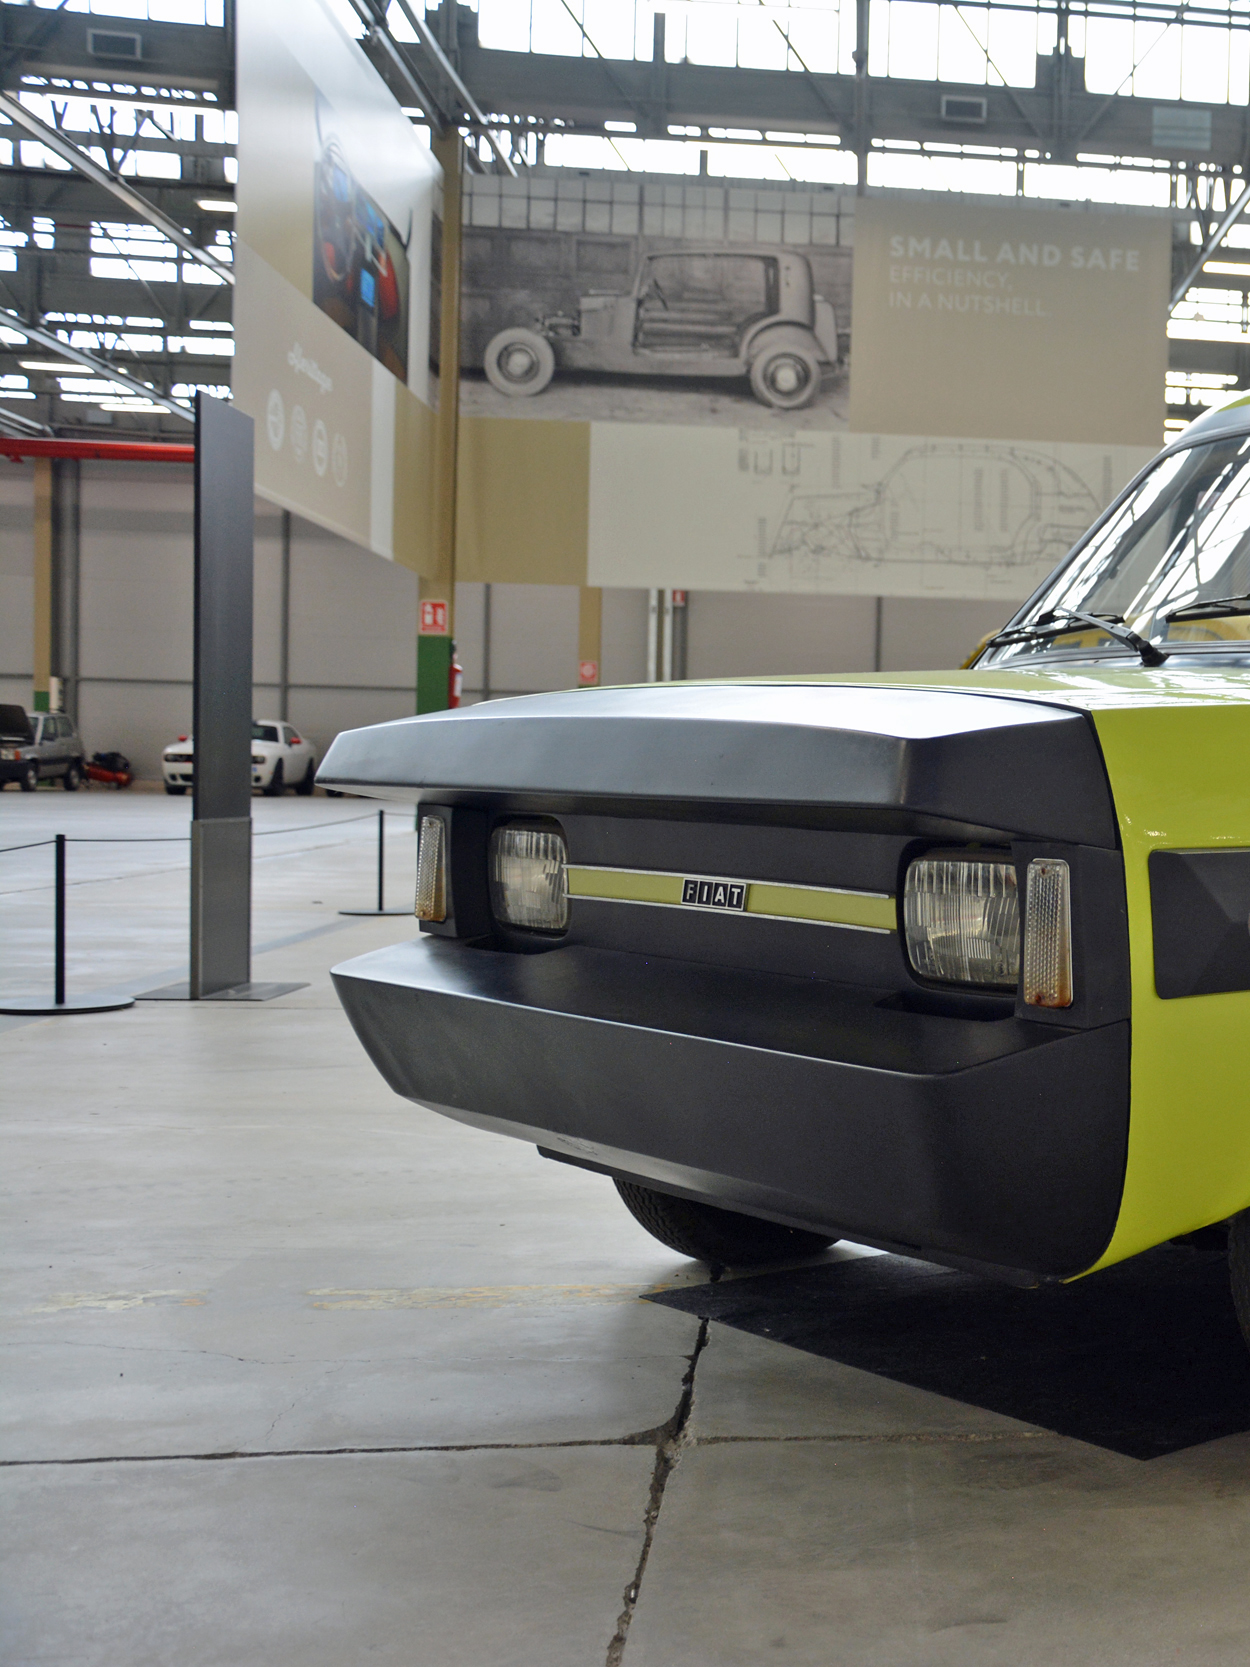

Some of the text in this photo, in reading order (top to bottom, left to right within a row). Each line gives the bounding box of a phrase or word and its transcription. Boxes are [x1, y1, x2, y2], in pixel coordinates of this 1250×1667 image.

[889, 235, 1140, 272] SMALL AND SAFE
[889, 265, 1013, 292] EFFICIENCY,
[889, 292, 912, 309] IN
[917, 294, 933, 310] A
[686, 884, 741, 905] FIAT
